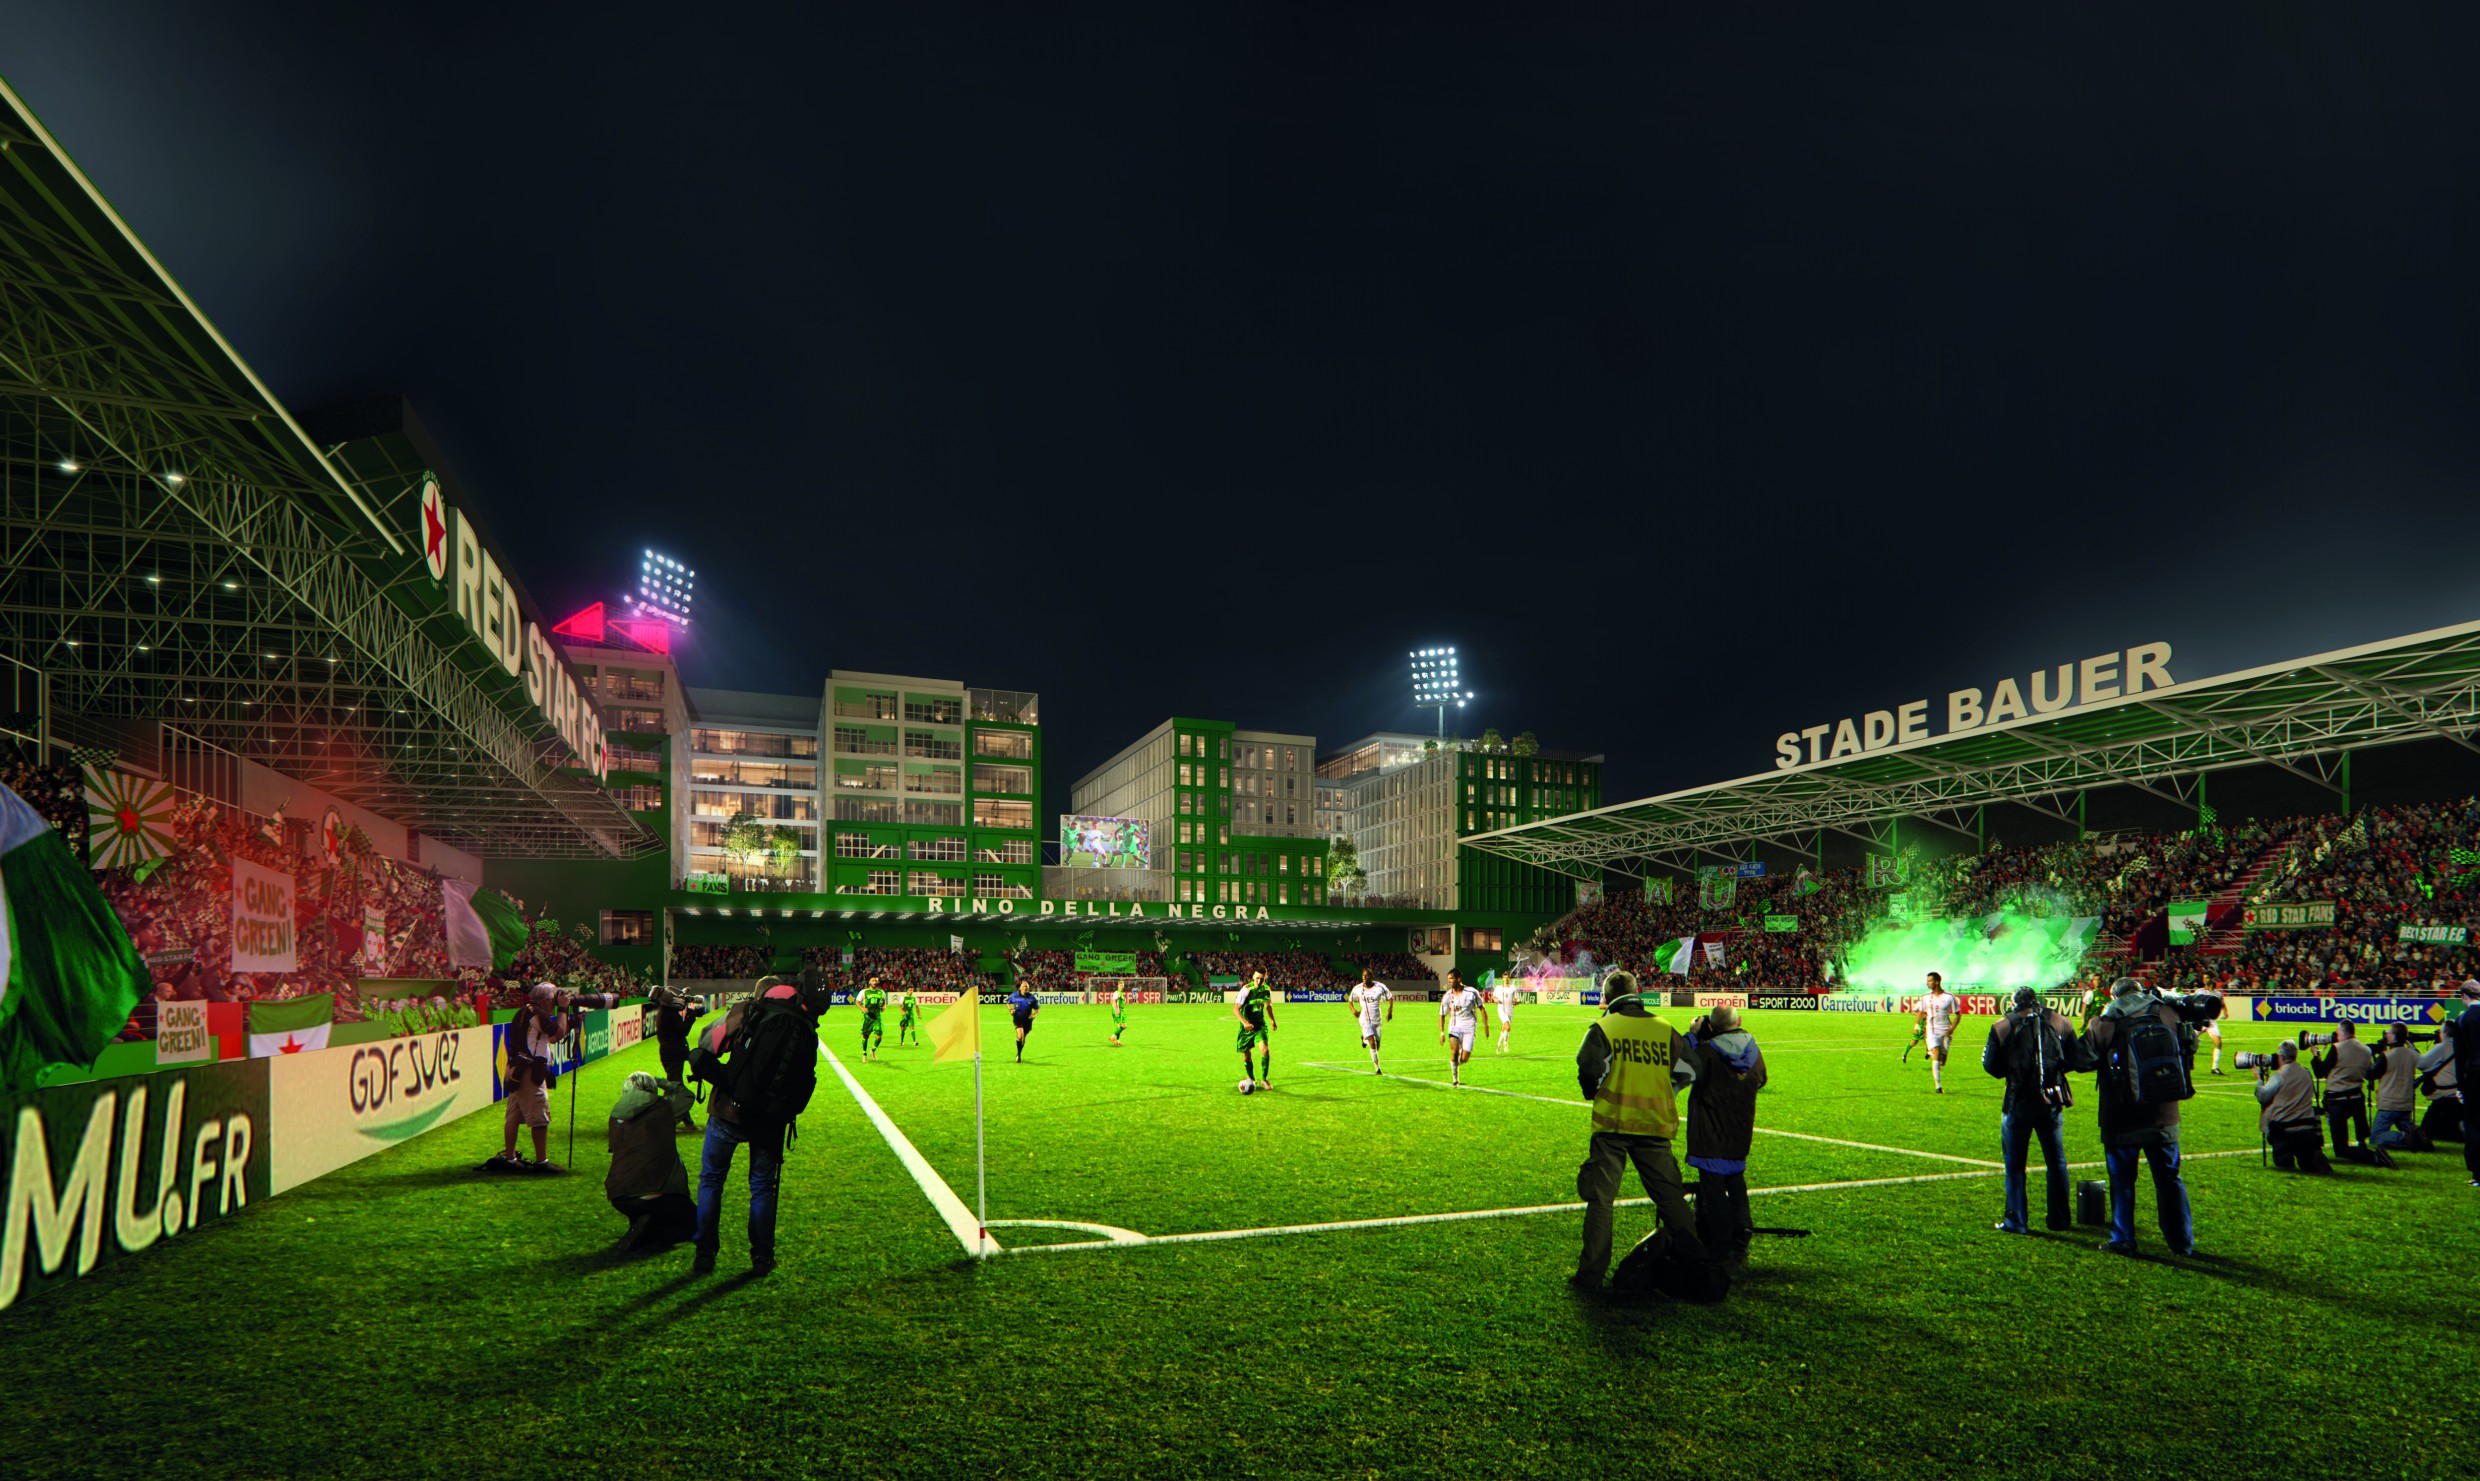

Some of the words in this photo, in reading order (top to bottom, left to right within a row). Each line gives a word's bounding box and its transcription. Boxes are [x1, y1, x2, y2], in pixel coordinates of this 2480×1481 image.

[456, 506, 522, 677] RED
[528, 621, 578, 753] STAR
[578, 697, 600, 777] FC
[1775, 699, 1929, 770] STADE
[1948, 641, 2177, 733] BAUER
[688, 872, 704, 881] RED
[707, 873, 728, 883] STAR
[702, 882, 727, 893] FANS
[244, 876, 287, 919] GANG
[928, 897, 1014, 914] RINO
[1040, 900, 1144, 917] DELLA
[1168, 903, 1270, 920] NEGRA
[2259, 908, 2278, 924] RED
[2281, 906, 2306, 924] STAR
[2308, 904, 2335, 923] FANS
[234, 916, 292, 957] GREEN!
[2419, 926, 2447, 941] STAR
[918, 994, 958, 1004] TROËN
[978, 995, 1002, 1004] PORT
[1143, 993, 1160, 1004] SFR
[1309, 991, 1343, 1003] Pasquier
[1643, 997, 1660, 1005] RICOLE
[1759, 997, 1788, 1009] SPORT
[1790, 997, 1816, 1009] 2000
[1821, 995, 1878, 1013] Carrefour
[1967, 996, 1996, 1015] SFR
[165, 1006, 200, 1028] GANG
[2275, 1002, 2317, 1014] brioche
[2320, 997, 2423, 1024] Pasquier
[158, 1025, 206, 1054] GREEN!
[1612, 1038, 1670, 1066] PRESSE
[349, 1043, 404, 1115] GDF
